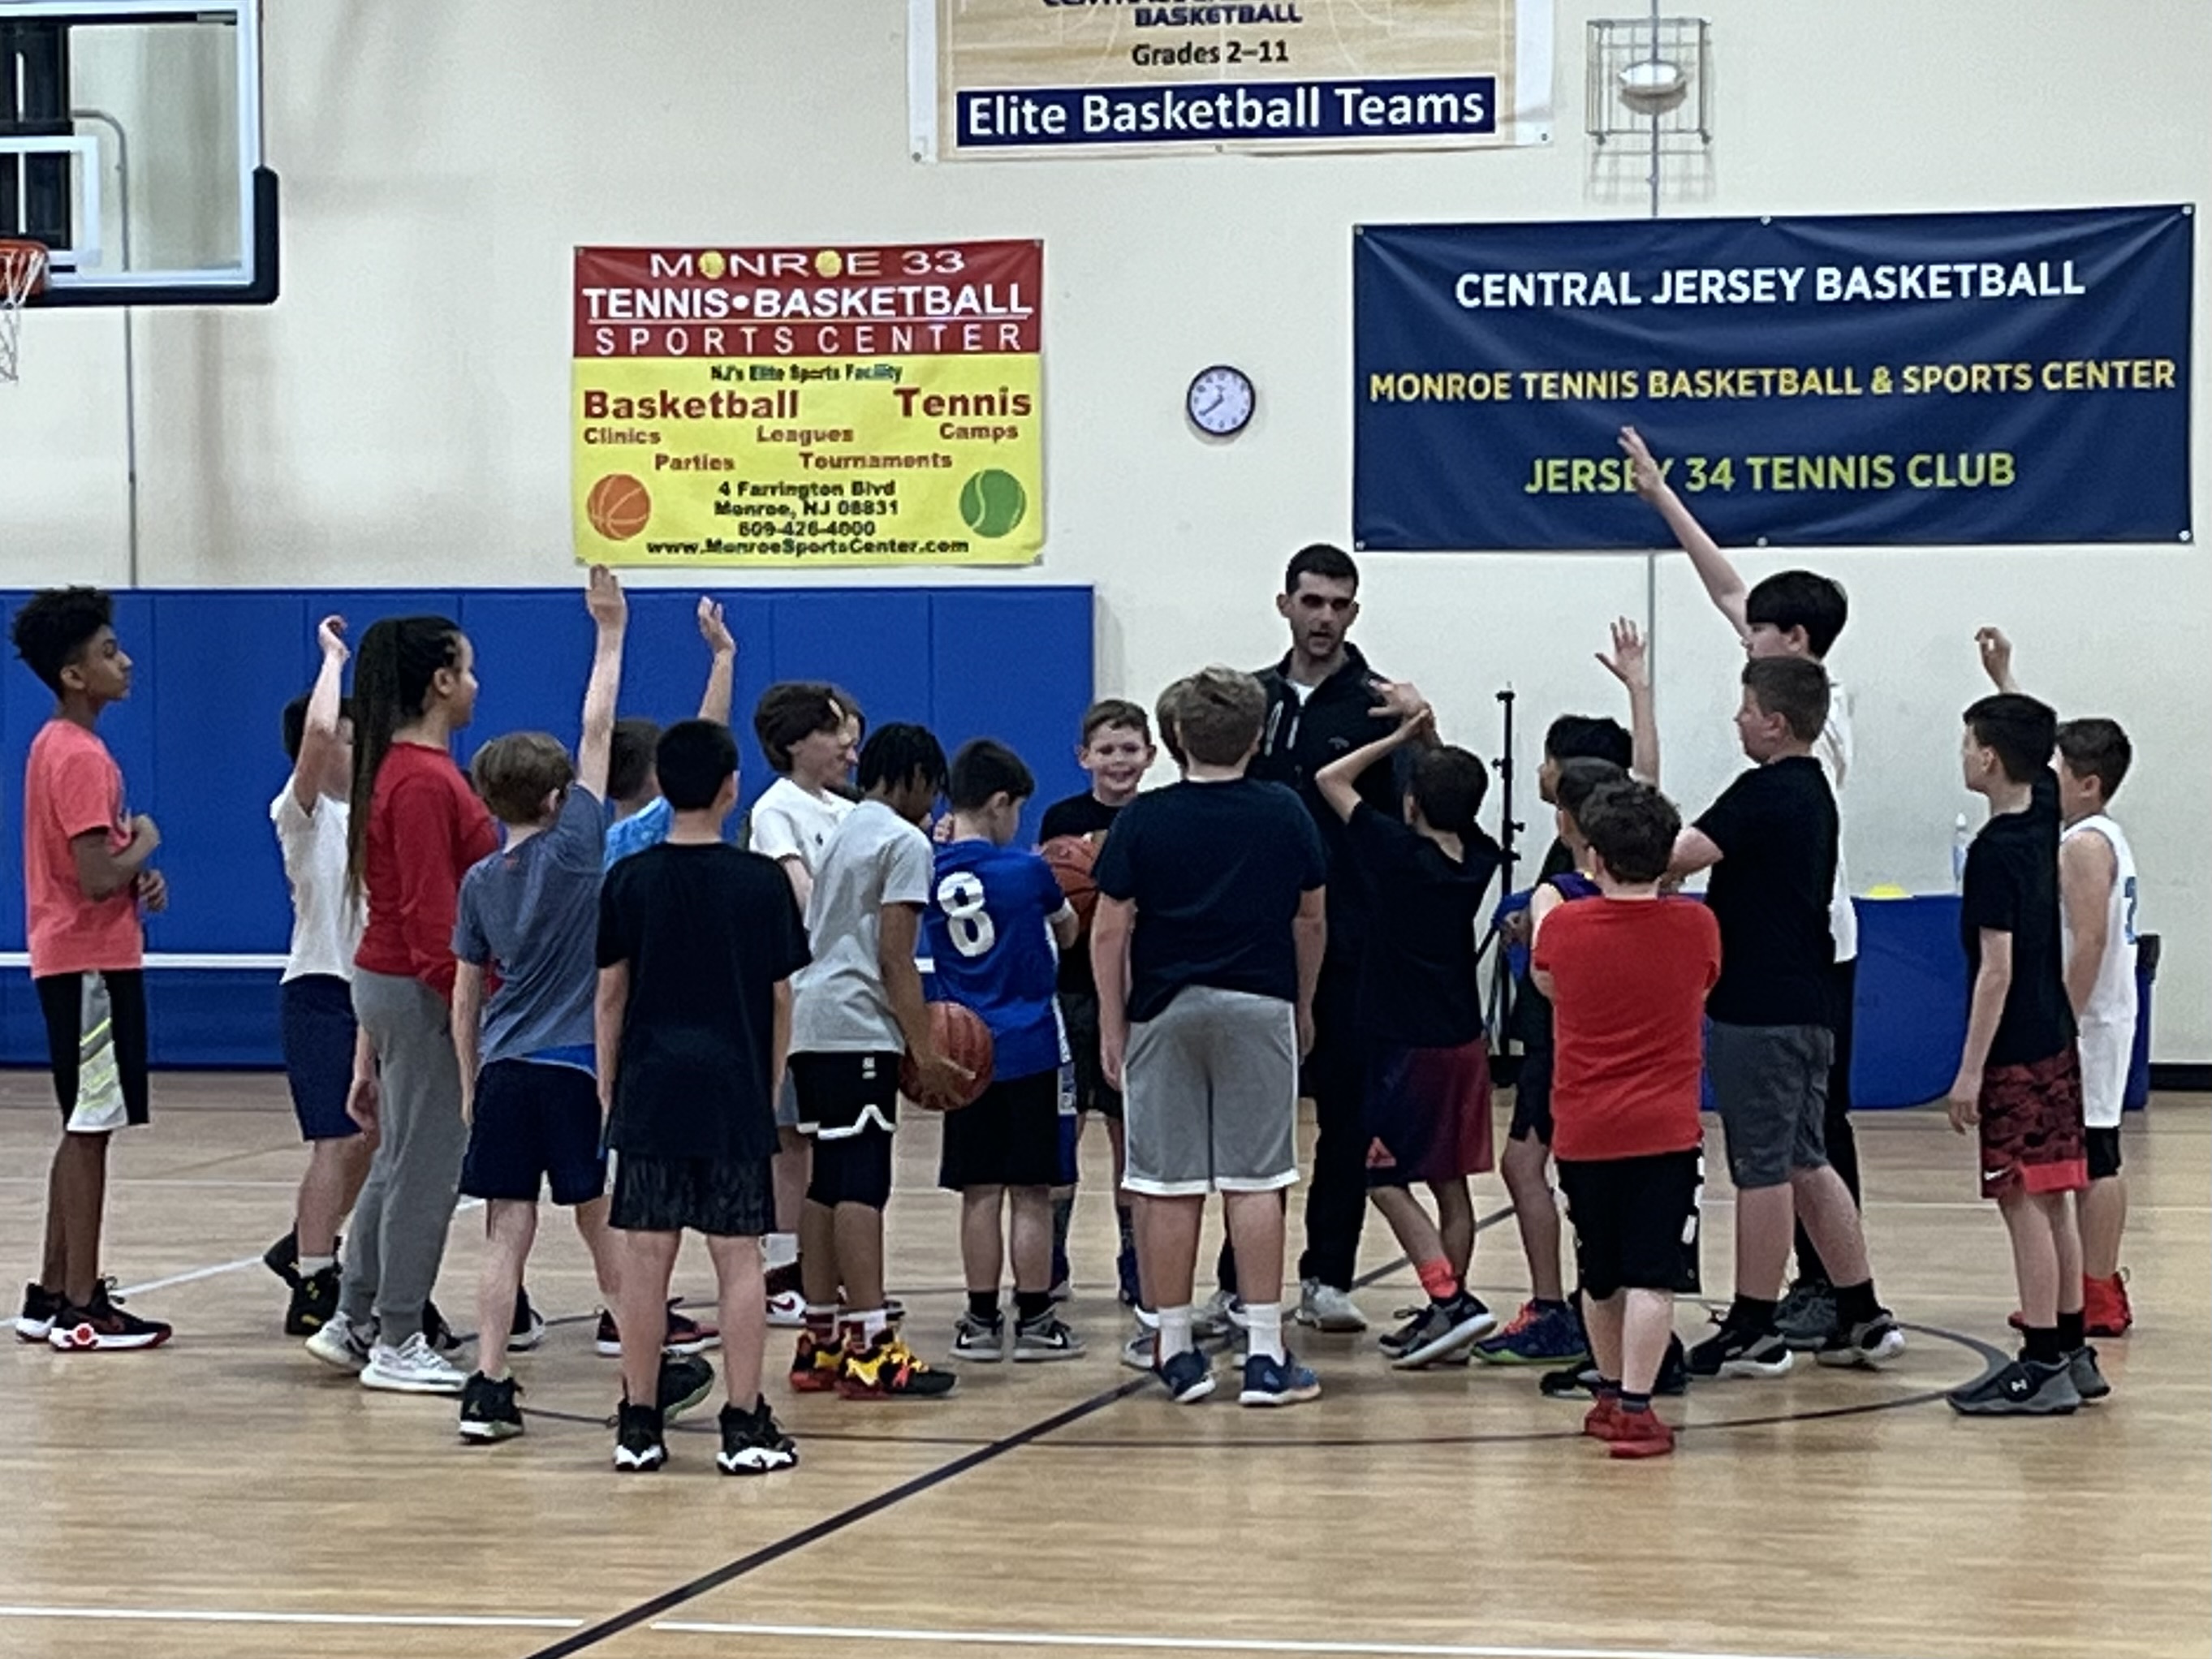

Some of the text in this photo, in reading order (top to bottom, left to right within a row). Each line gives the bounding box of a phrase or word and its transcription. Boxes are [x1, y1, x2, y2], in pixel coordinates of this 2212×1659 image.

[1135, 4, 1302, 27] BASKETBALL
[1132, 43, 1219, 65] Grades
[971, 86, 1485, 136] Elite Basketball Teams
[902, 251, 965, 274] 33
[1456, 260, 2085, 308] CENTRAL JERSEY BASKETBALL
[790, 364, 840, 382] Sports
[846, 364, 903, 384] Facility
[1370, 360, 2176, 402] MONROE TENNIS BASKETBALL & SPORTS CENTER
[584, 387, 1032, 419] Basketball Tennis
[584, 423, 1018, 446] Clinics Leagues Camps
[655, 452, 952, 471] Parties Tournaments
[1684, 457, 1736, 492] 34
[1745, 455, 1895, 490] TENNIS
[1906, 451, 2016, 489] CLUB
[718, 480, 895, 502] 4 Farrington Blvd
[714, 500, 898, 519] Monroe, NJ 08831
[646, 538, 968, 556] www.MonroeSportsCenter.com
[937, 871, 995, 957] 8
